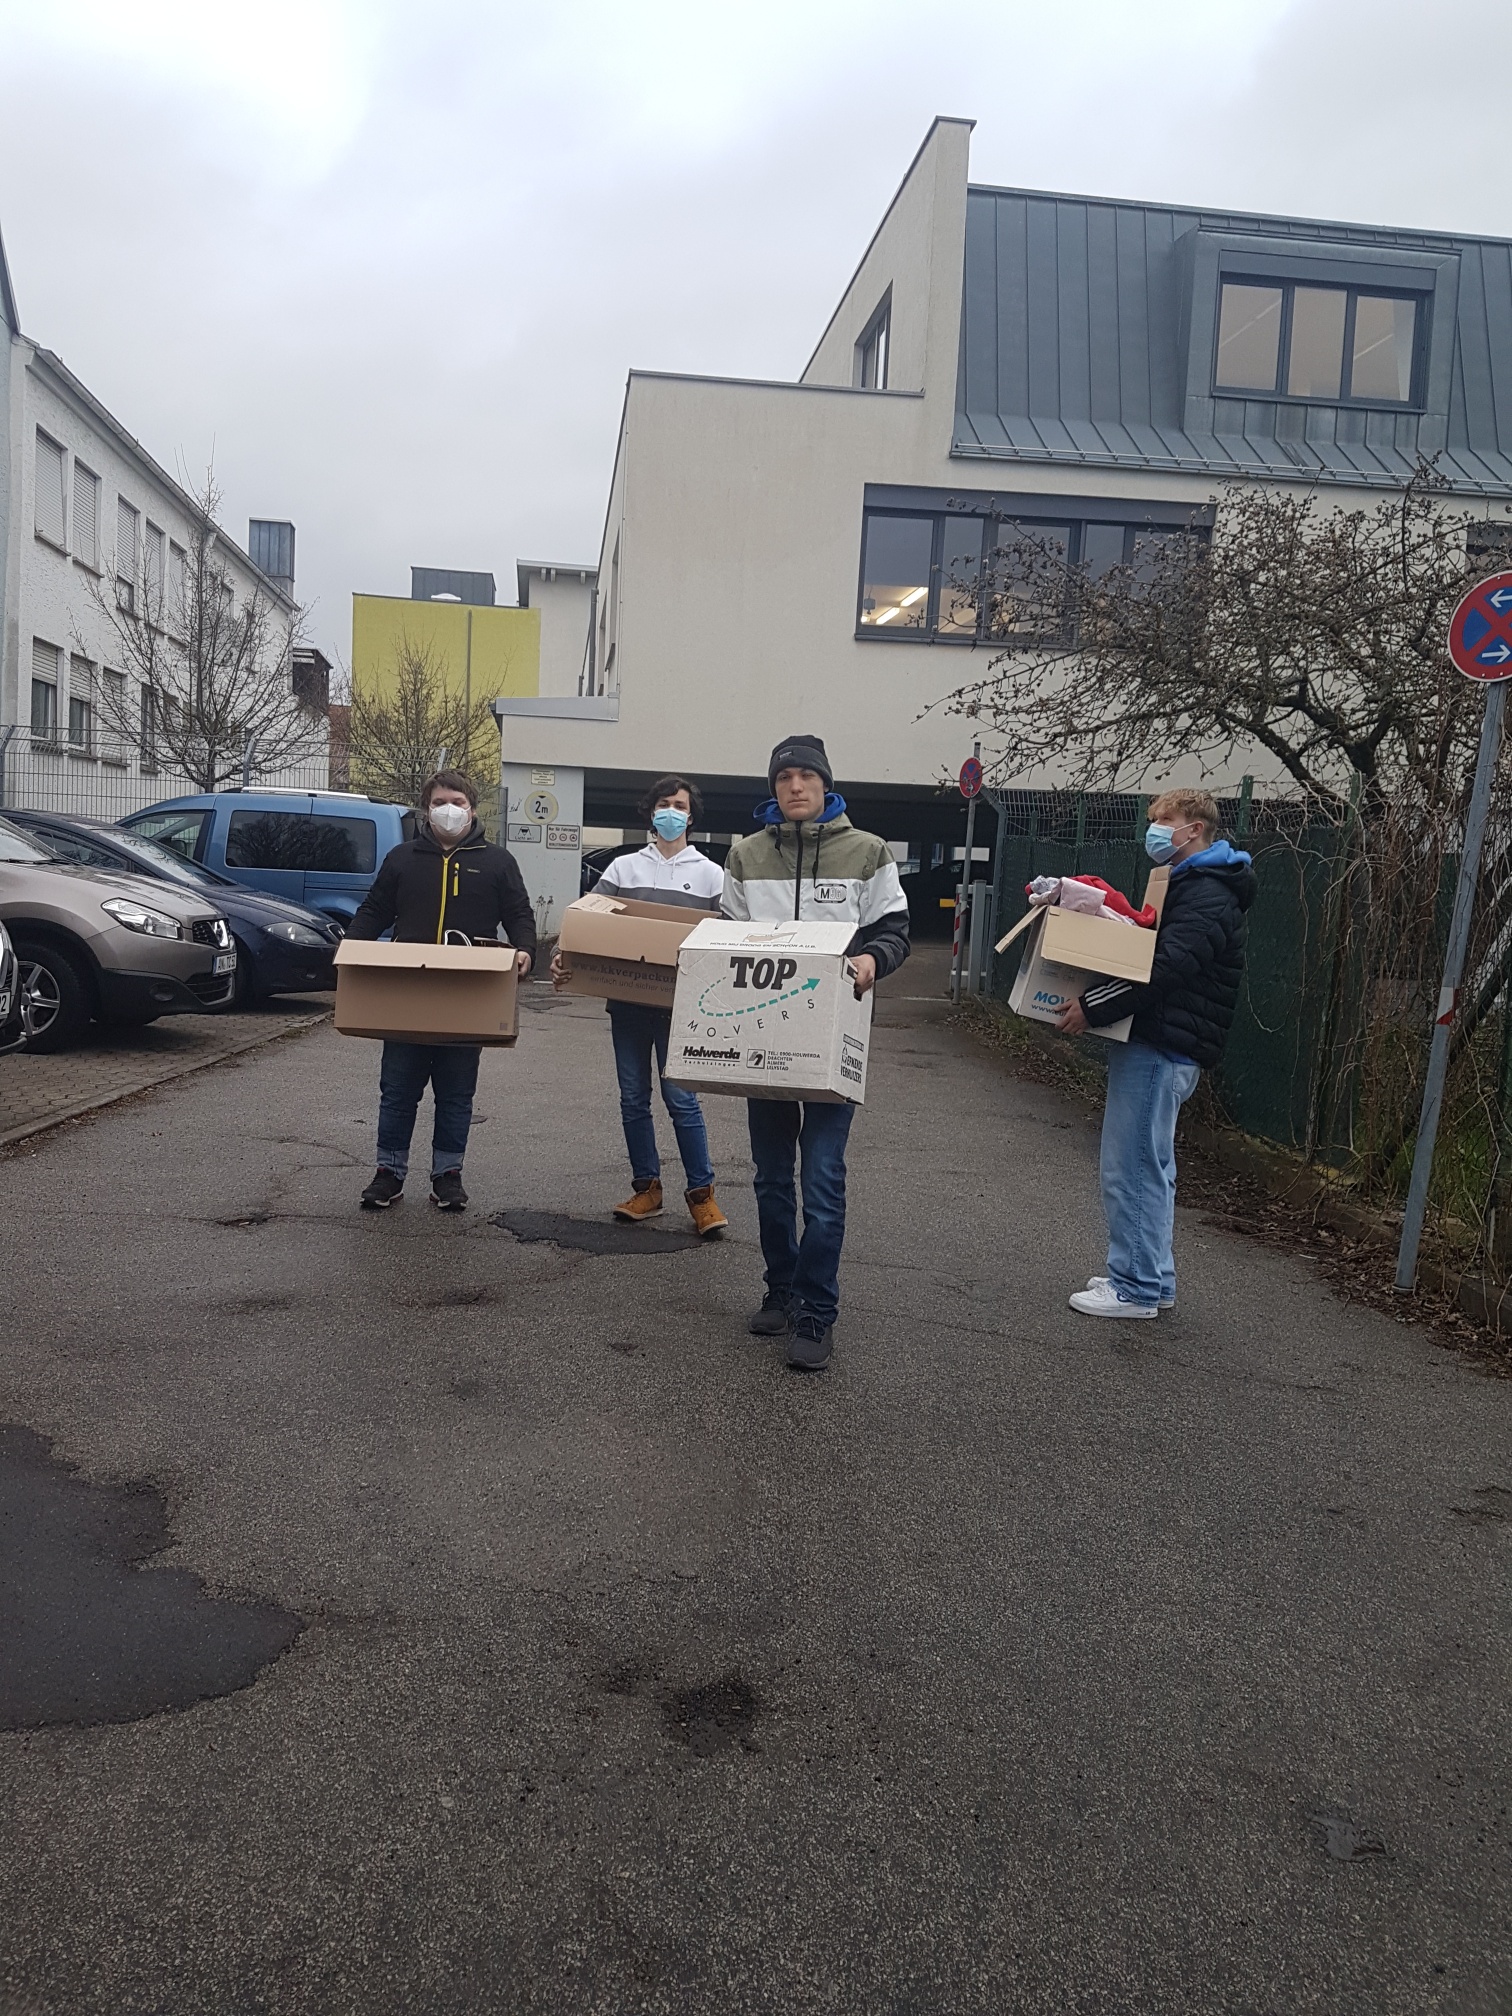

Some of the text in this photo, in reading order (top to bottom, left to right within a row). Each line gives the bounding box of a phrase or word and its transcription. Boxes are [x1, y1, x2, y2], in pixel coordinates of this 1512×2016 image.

[535, 800, 548, 814] 2 m
[730, 956, 797, 990] TOP
[619, 980, 633, 988] und
[635, 983, 658, 991] sicher
[688, 998, 815, 1038] MOVERS
[683, 1046, 740, 1059] Holwerda
